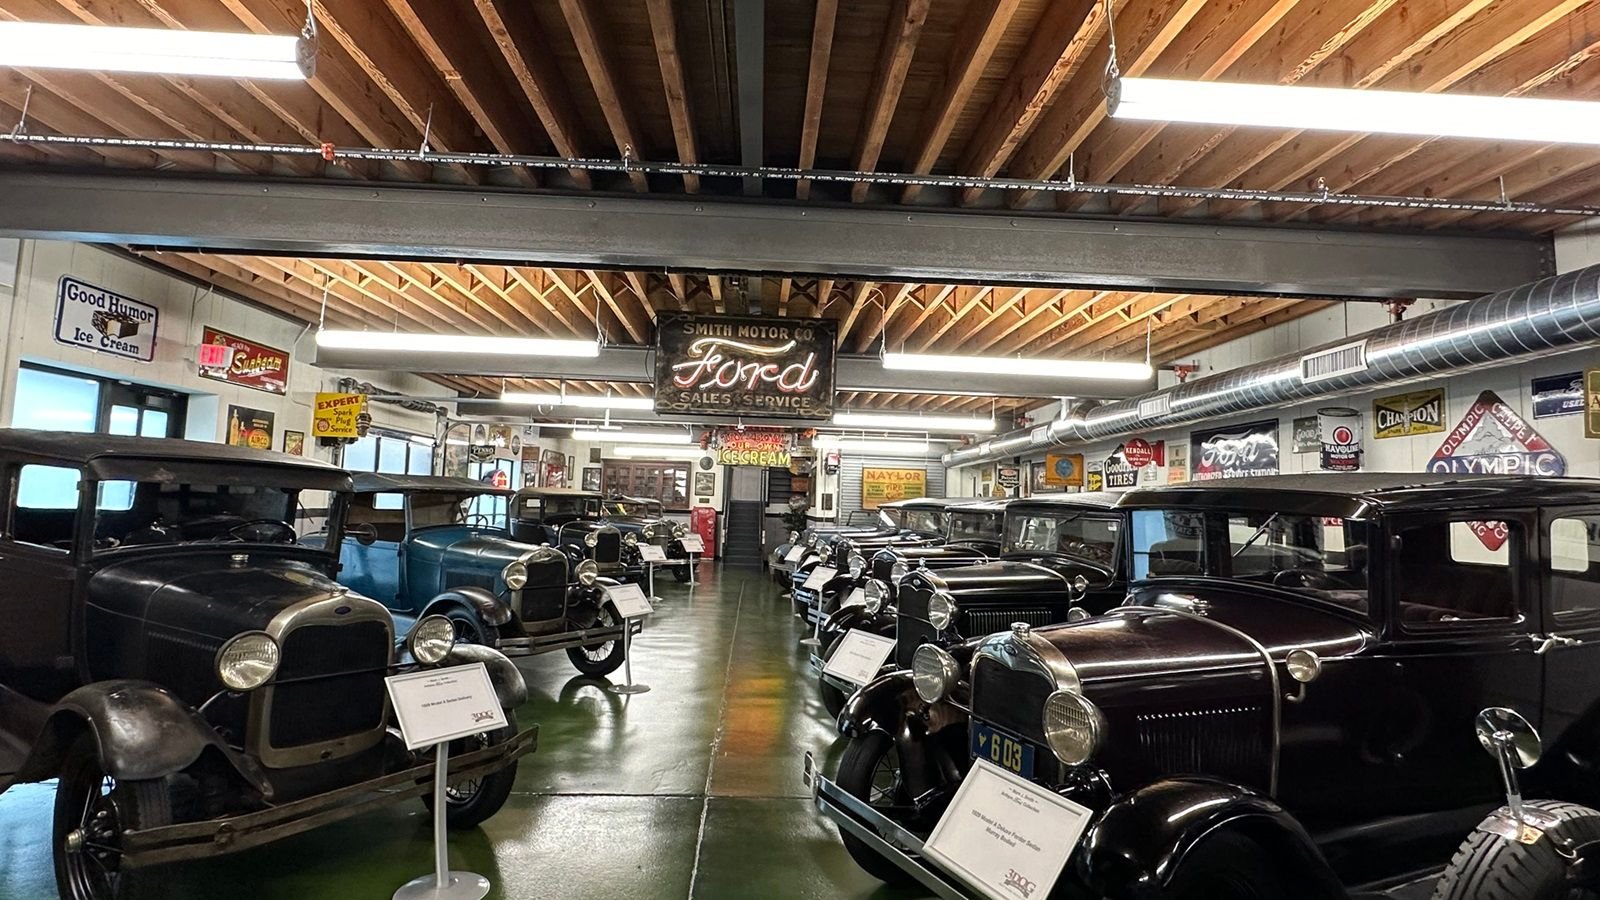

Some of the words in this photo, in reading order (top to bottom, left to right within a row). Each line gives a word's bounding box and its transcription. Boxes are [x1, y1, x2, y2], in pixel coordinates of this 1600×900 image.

[68, 284, 105, 309] Good
[108, 296, 153, 323] Humor
[683, 323, 732, 337] SMITH
[738, 325, 789, 339] MOTOR
[794, 328, 815, 341] CO.
[73, 327, 93, 343] Ice
[100, 336, 139, 354] Cream
[231, 352, 281, 374] Sunbeam
[672, 338, 819, 392] Ford
[318, 395, 360, 410] EXPERT
[680, 392, 731, 404] SALES
[743, 394, 811, 408] SERVICE
[333, 408, 352, 417] Spark
[1377, 400, 1439, 429] CHAMPION
[330, 425, 353, 433] Service
[335, 417, 351, 427] Plug
[1441, 403, 1485, 456] OLYMPIC
[730, 441, 751, 449] OUR
[756, 442, 781, 450] OWN
[1125, 447, 1151, 455] KENDALL
[1325, 444, 1359, 454] HAVOLINE
[717, 449, 738, 463] ICE
[741, 449, 790, 466] CREAM
[1432, 453, 1556, 476] OLYMPIC
[866, 470, 921, 481] NAYLOR
[1108, 473, 1134, 486] TIRES
[1005, 868, 1036, 893] 3DOG
